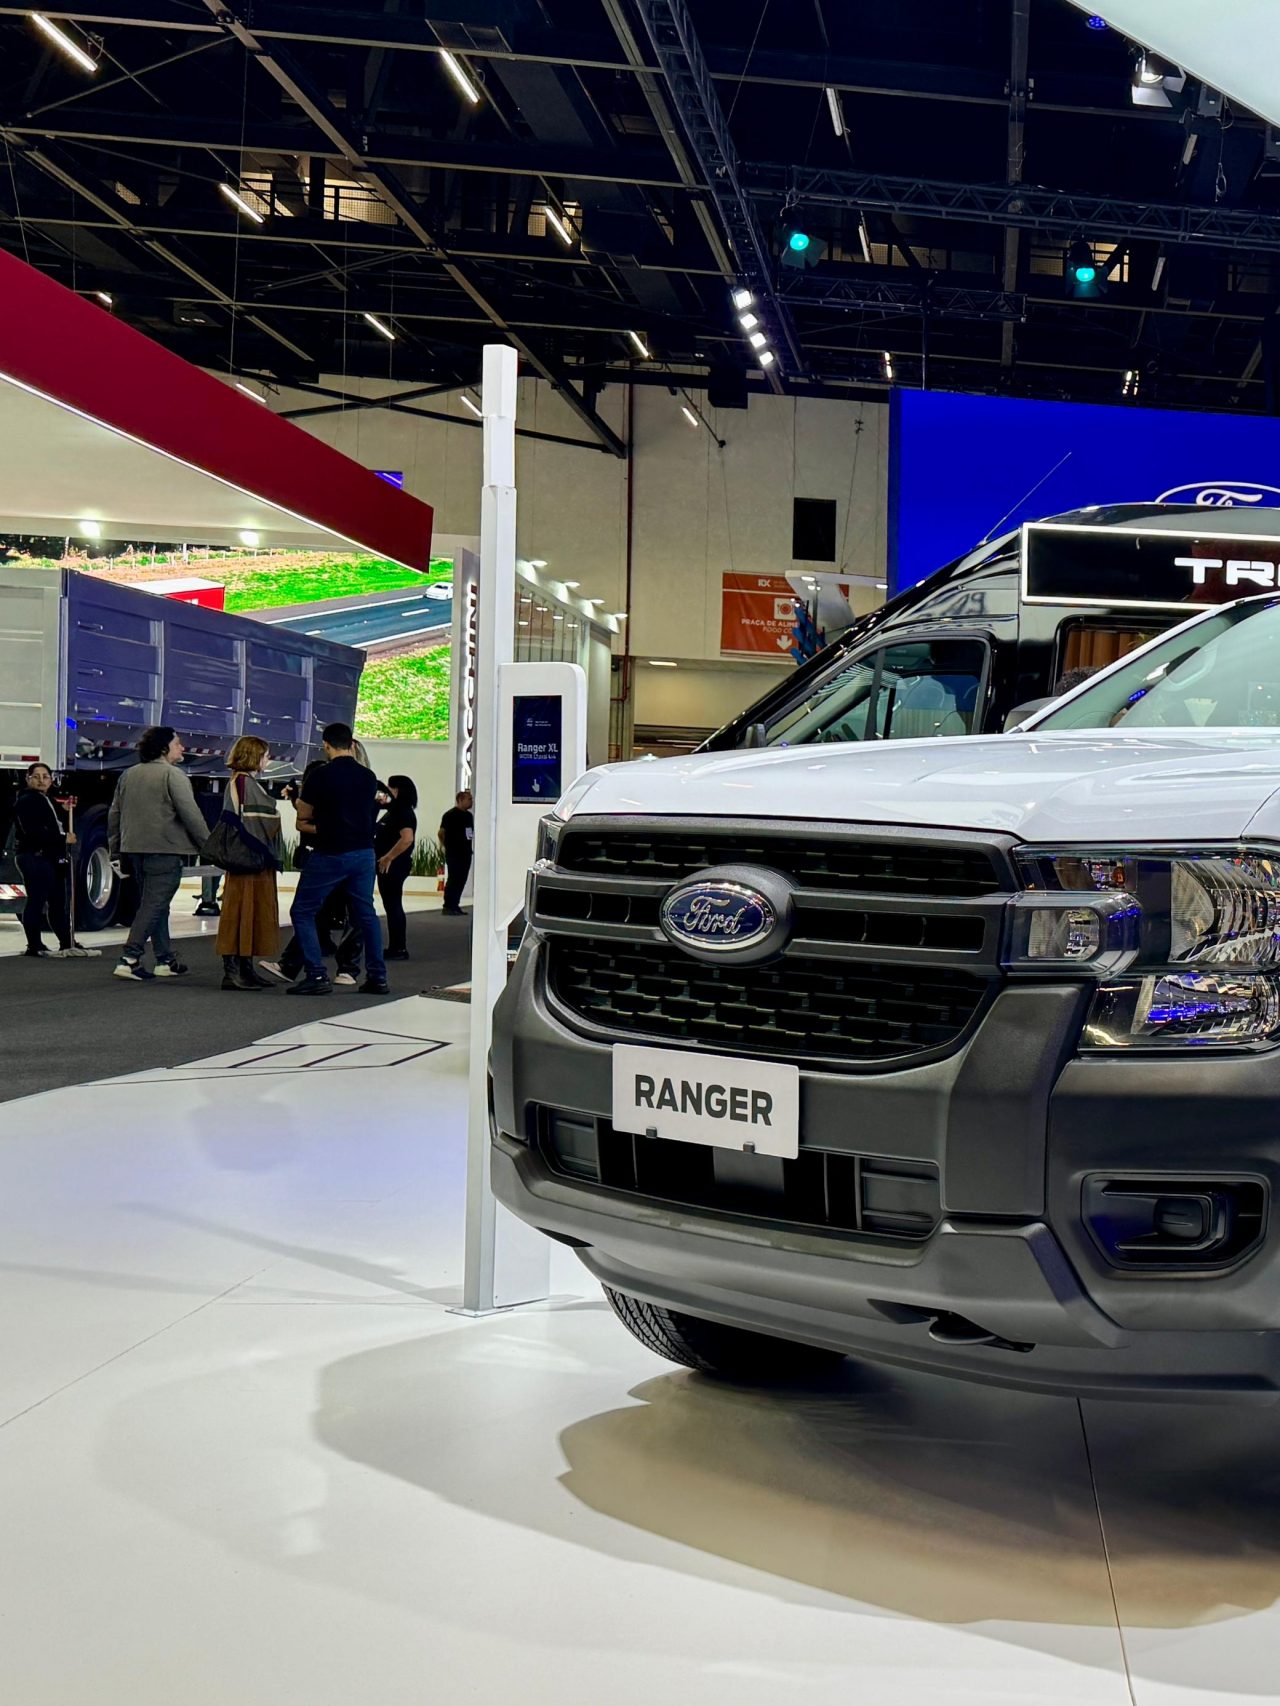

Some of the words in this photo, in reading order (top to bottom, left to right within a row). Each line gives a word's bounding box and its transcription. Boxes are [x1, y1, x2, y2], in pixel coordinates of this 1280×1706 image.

[461, 583, 478, 792] FACCHINI
[517, 743, 547, 754] Ranger
[548, 743, 559, 752] XL
[683, 895, 748, 935] Ford
[634, 1073, 774, 1127] RANGER
